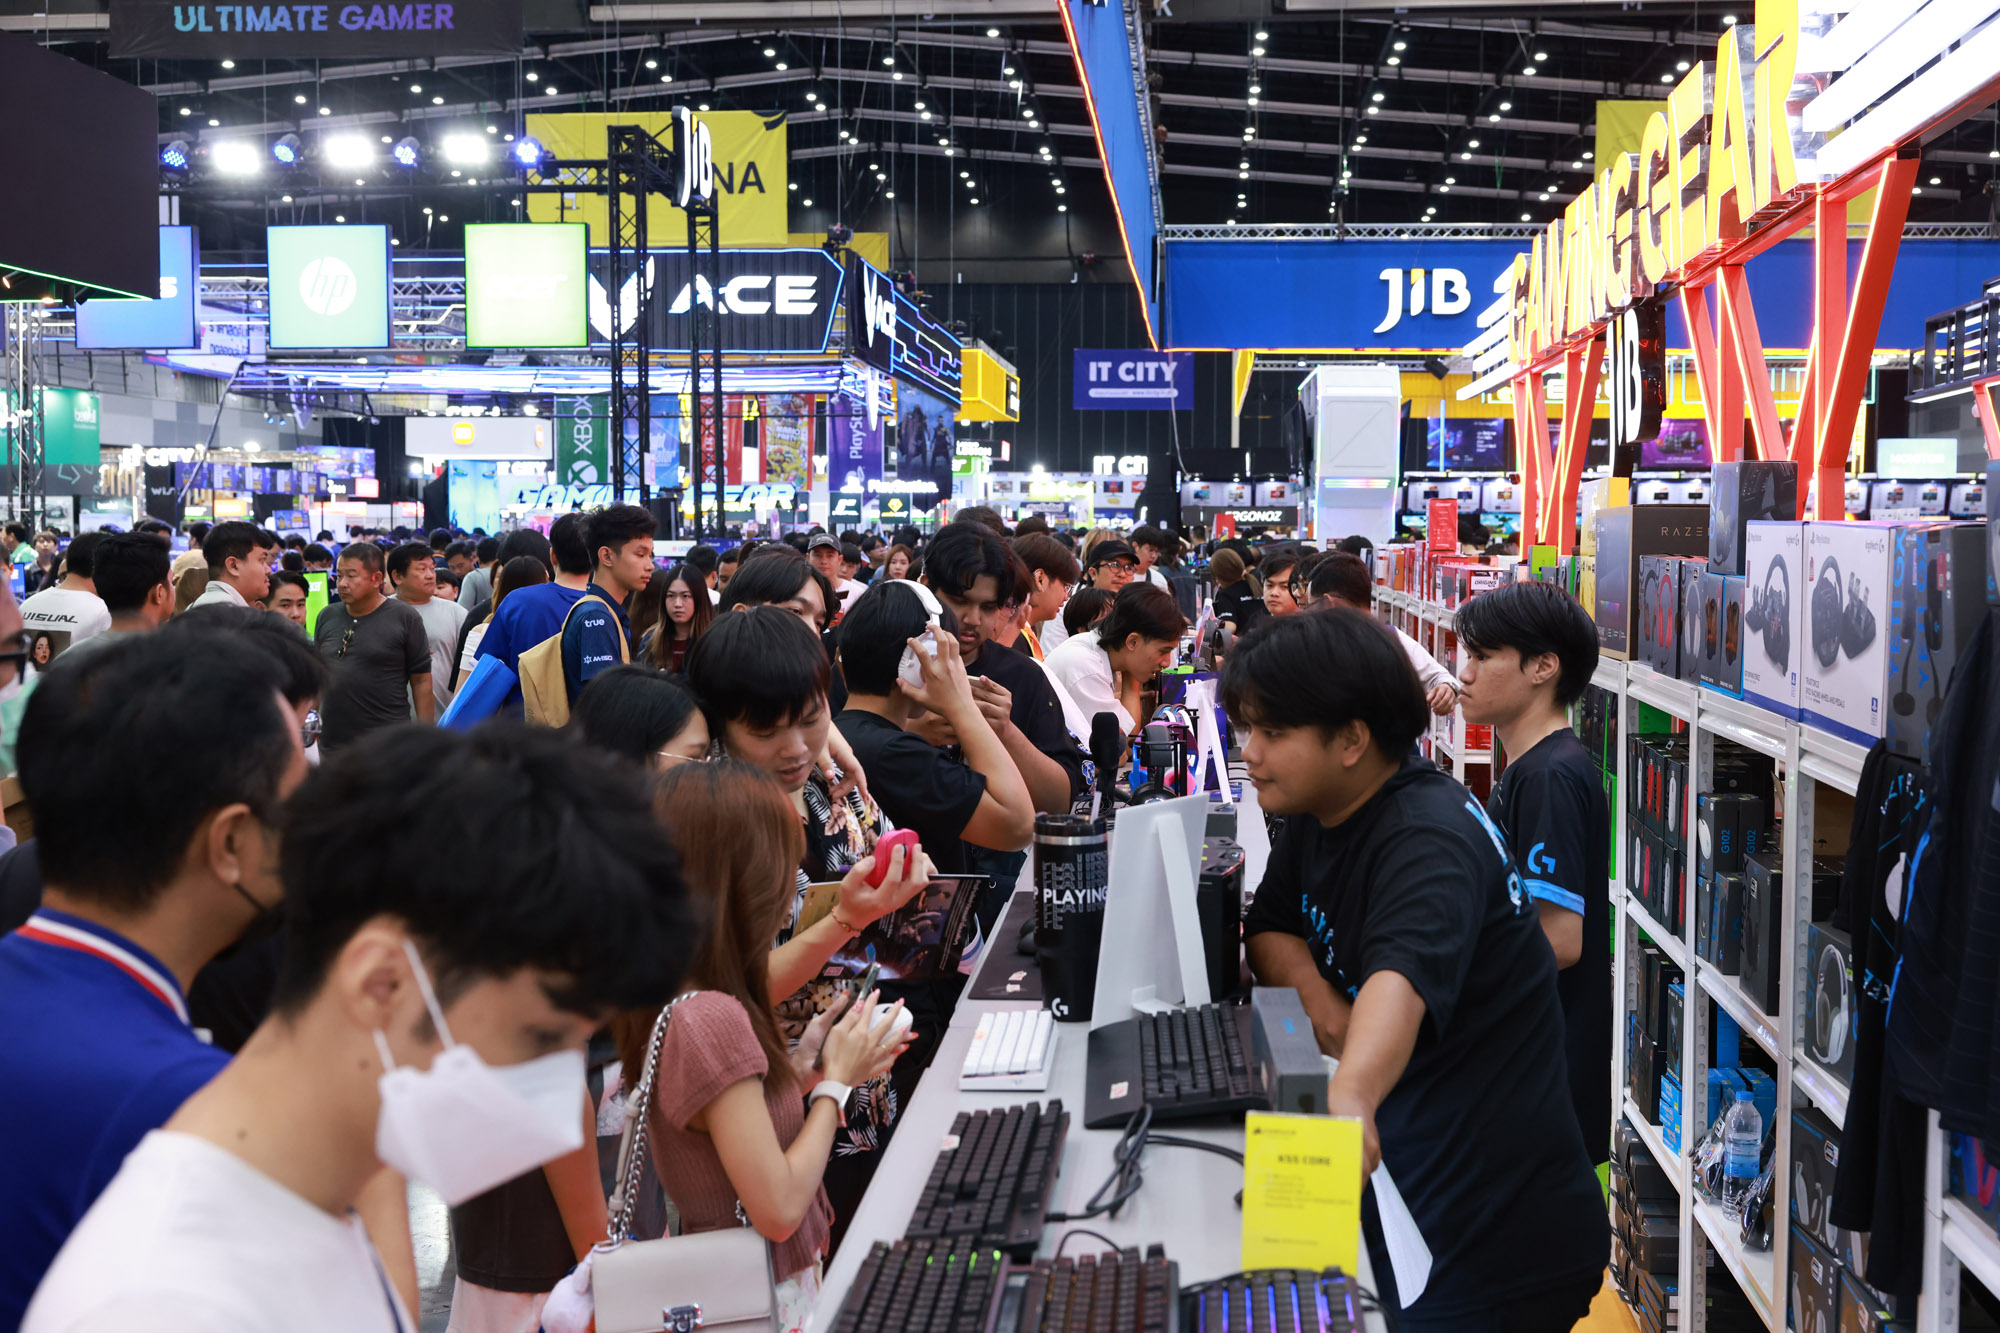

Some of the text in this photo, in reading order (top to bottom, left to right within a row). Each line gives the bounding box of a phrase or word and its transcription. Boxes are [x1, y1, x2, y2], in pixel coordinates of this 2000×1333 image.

[174, 4, 455, 32] ULTIMATE GAMER
[1508, 0, 1799, 365] GAMING GEAR
[1088, 361, 1178, 382] IT CITY
[574, 395, 593, 455] XBOX
[1093, 455, 1116, 476] IT
[1660, 526, 1710, 537] RAZE
[584, 618, 605, 628] true
[1721, 828, 1731, 854] G102
[1746, 828, 1756, 854] G102
[1043, 885, 1108, 905] PLAYING
